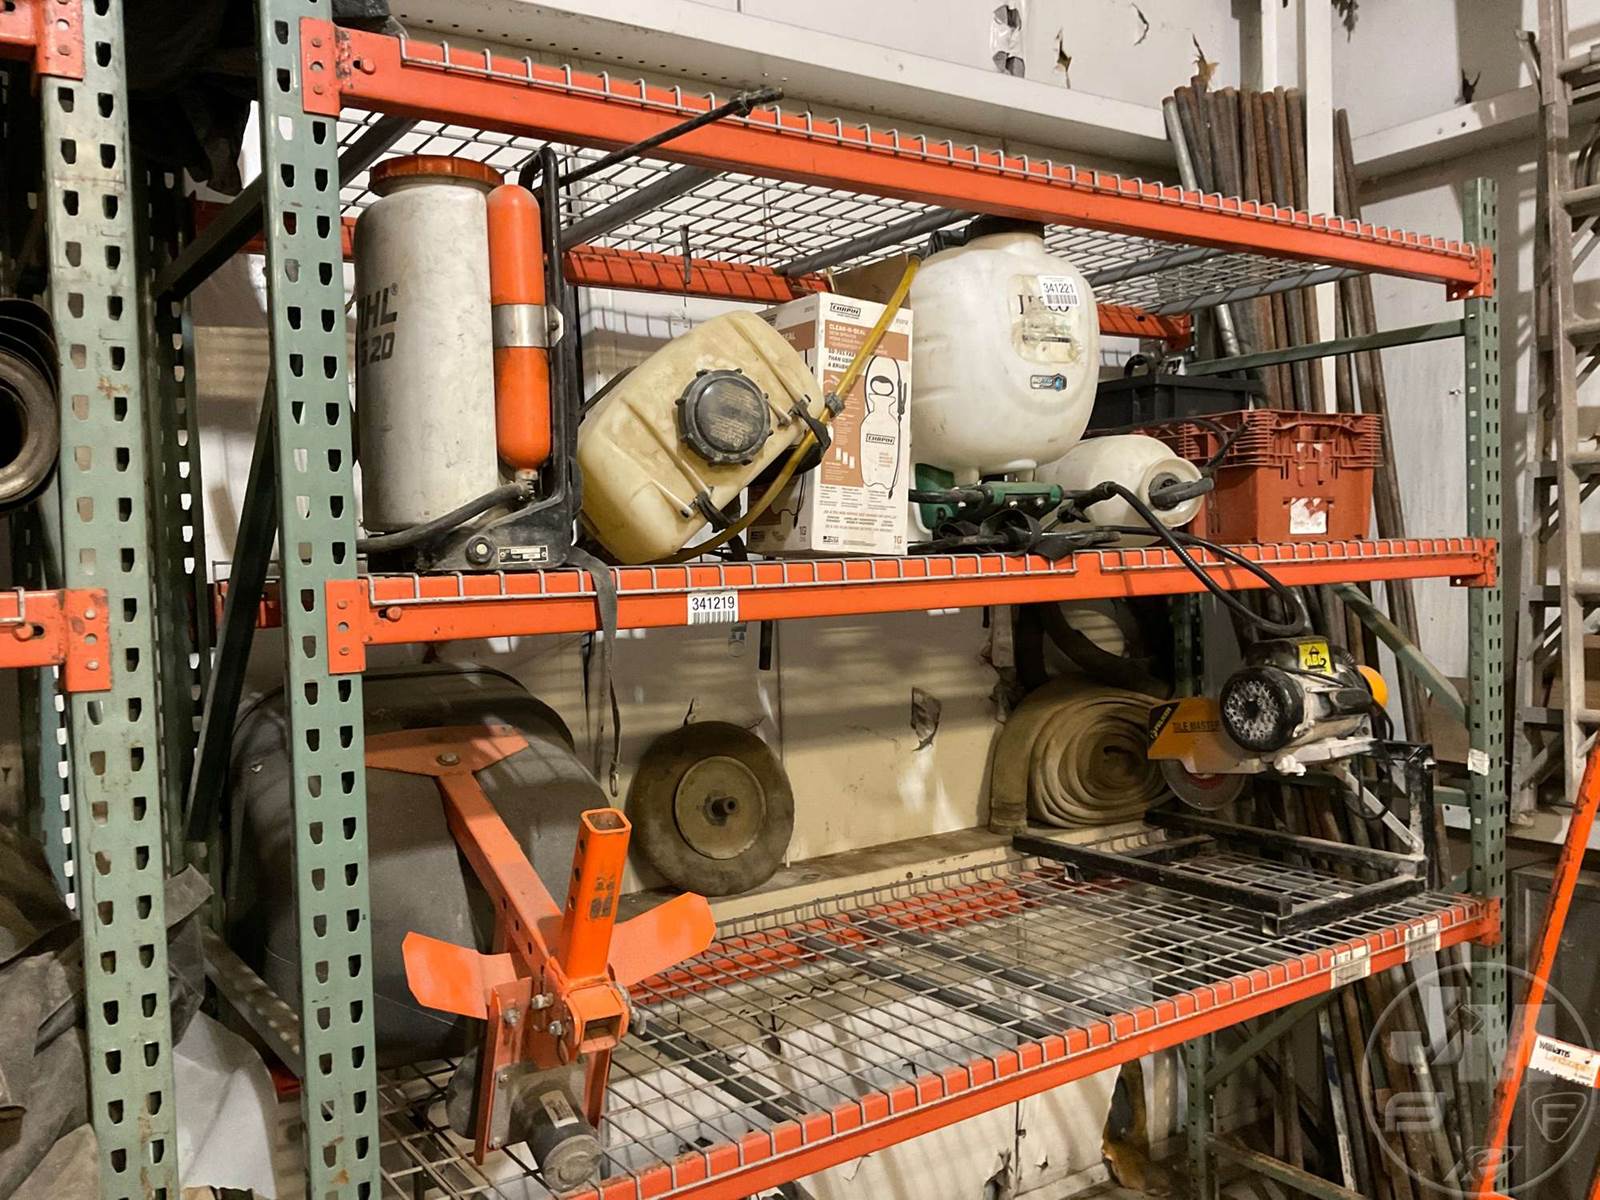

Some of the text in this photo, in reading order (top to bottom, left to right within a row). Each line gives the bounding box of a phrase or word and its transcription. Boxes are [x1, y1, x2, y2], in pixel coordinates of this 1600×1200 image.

[1043, 283, 1075, 294] 341221
[360, 287, 398, 331] IHL
[369, 331, 396, 364] 20
[692, 596, 735, 611] 341219
